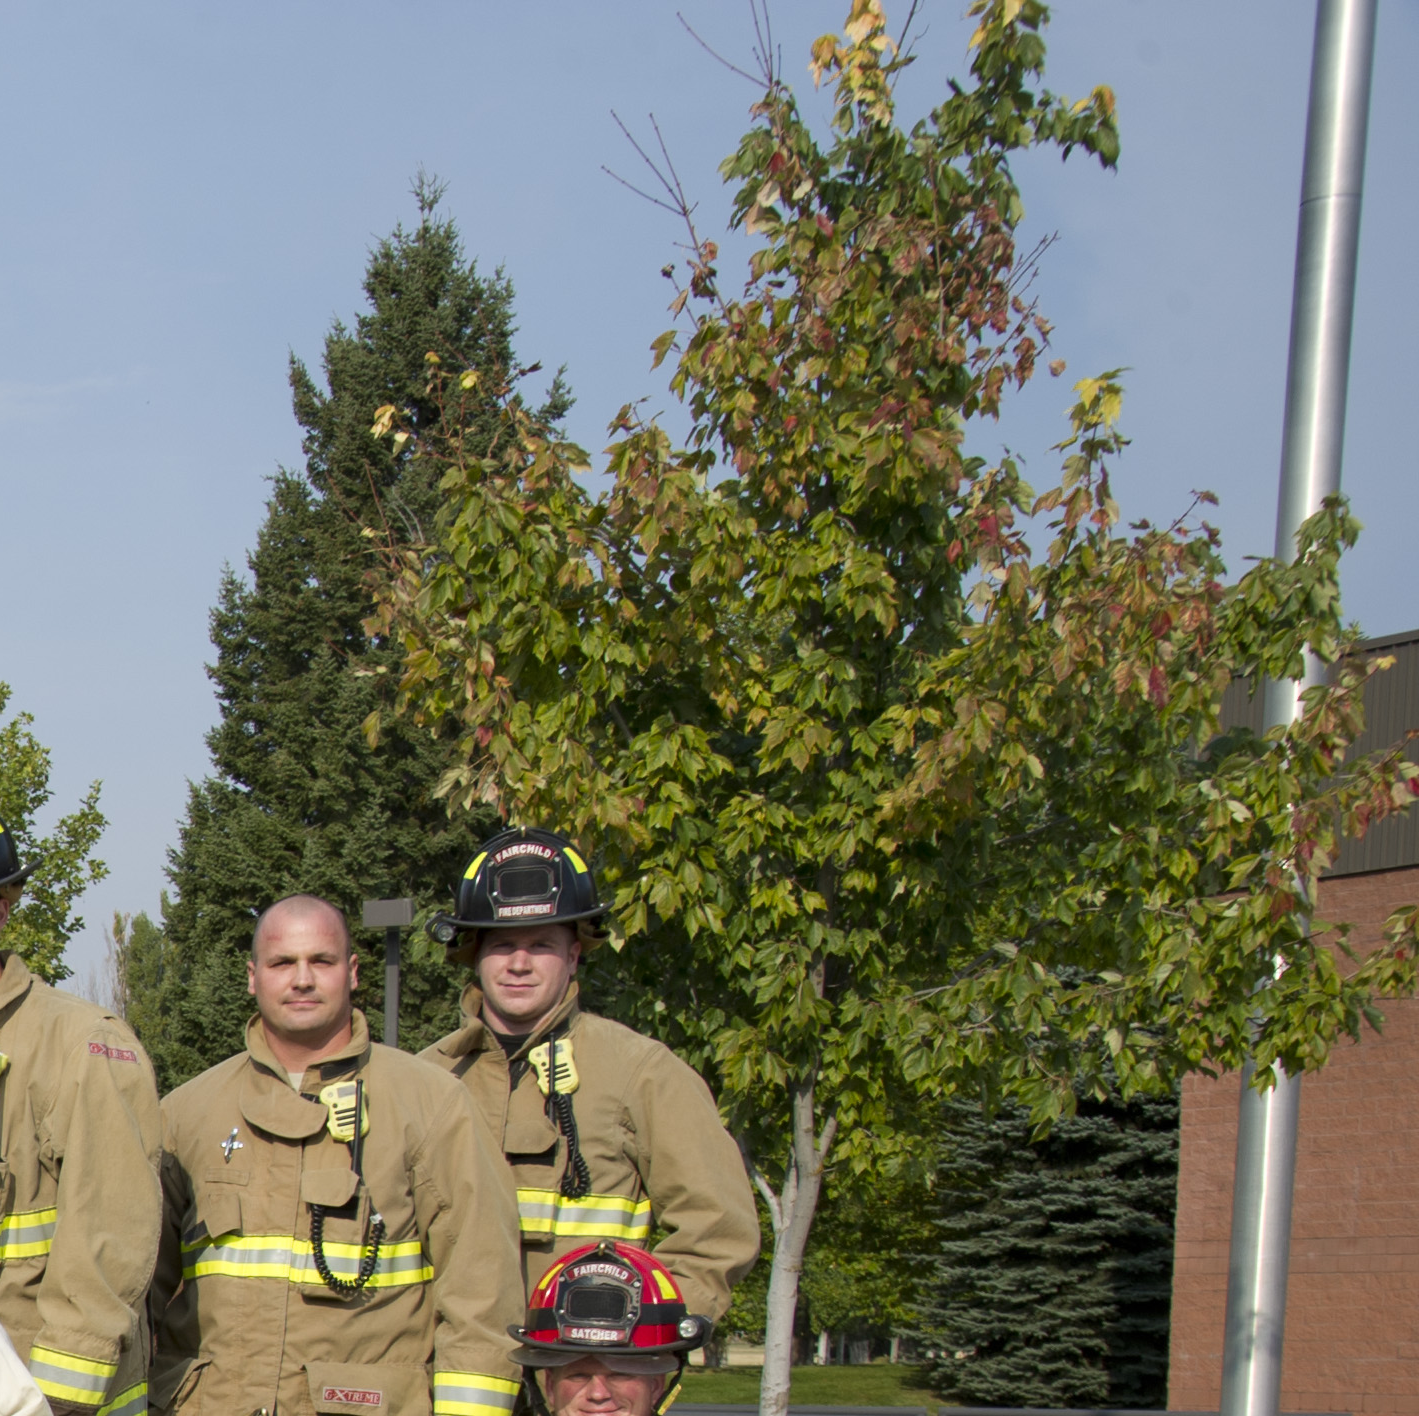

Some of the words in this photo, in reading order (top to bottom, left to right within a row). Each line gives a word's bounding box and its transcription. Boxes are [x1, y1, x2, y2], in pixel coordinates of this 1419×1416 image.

[495, 844, 551, 862] FAIRCHILD
[573, 1264, 629, 1280] FAIRCHILD
[571, 1328, 618, 1340] SATCHER
[325, 1389, 380, 1404] GXTREME
